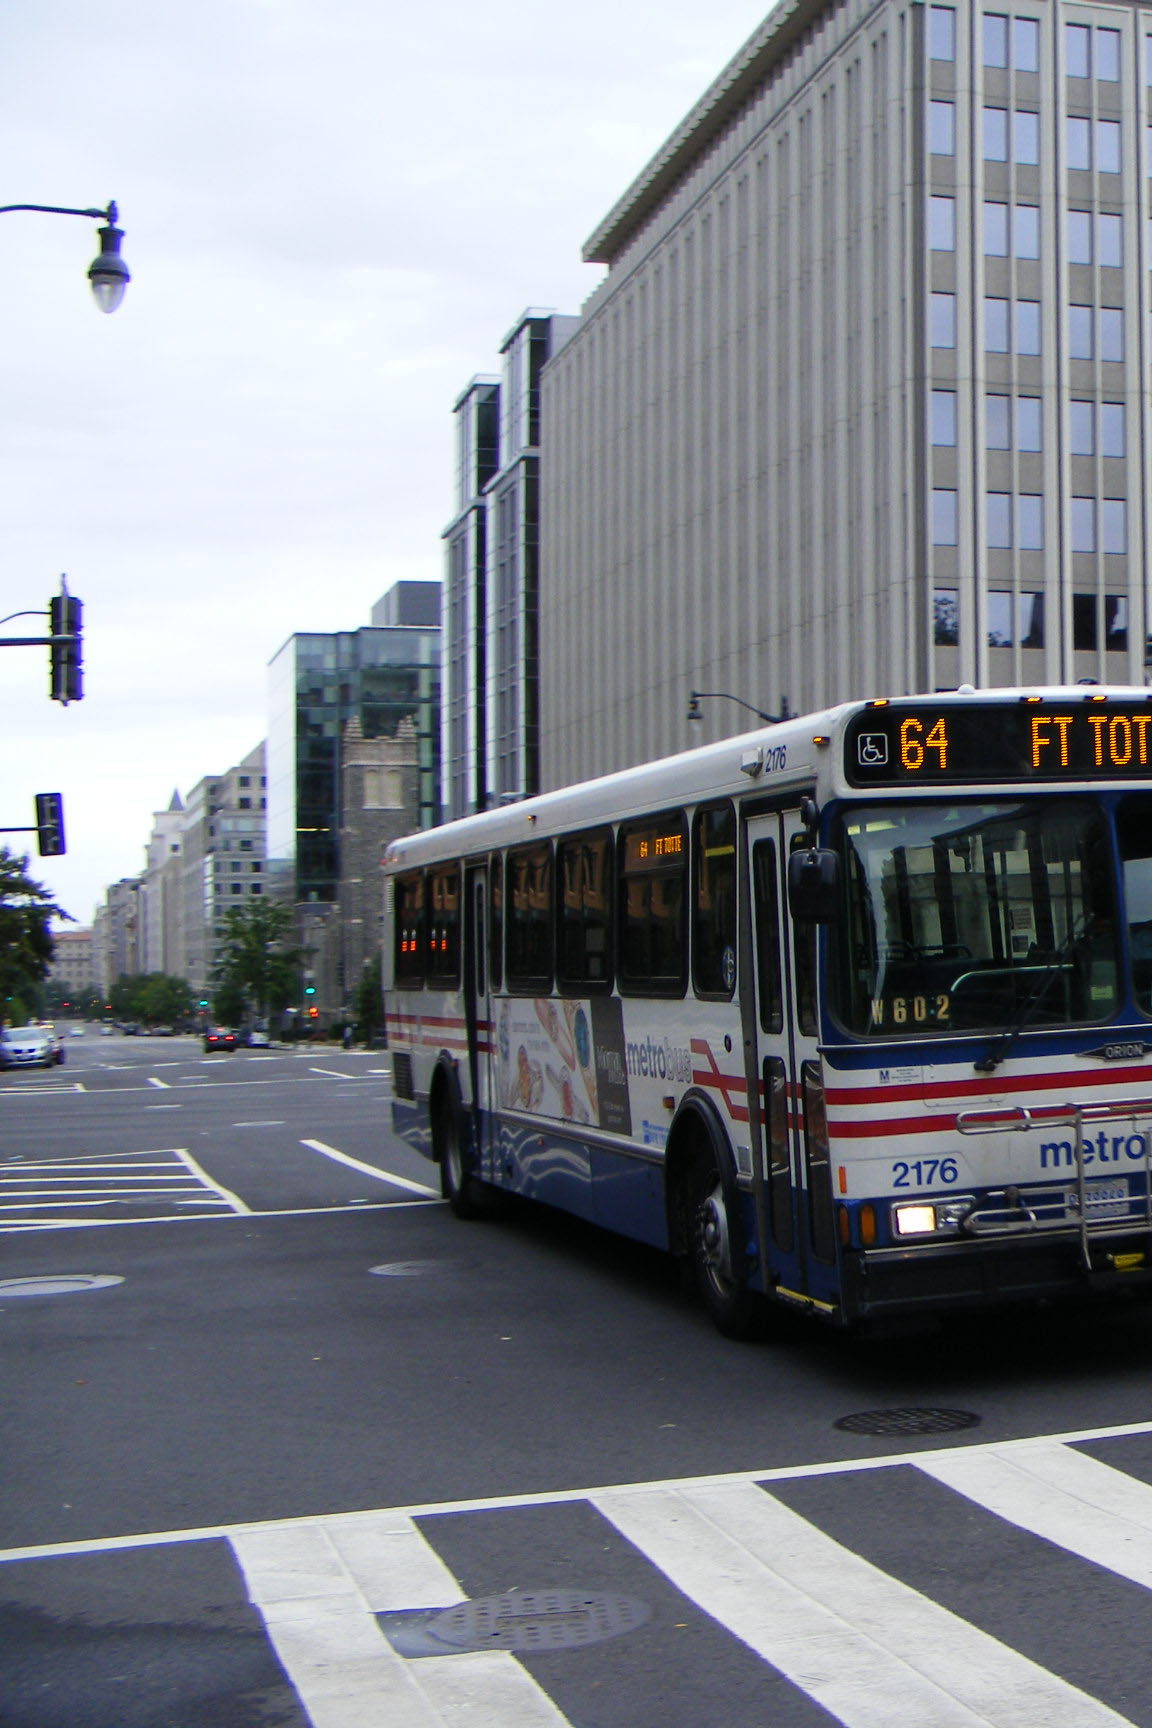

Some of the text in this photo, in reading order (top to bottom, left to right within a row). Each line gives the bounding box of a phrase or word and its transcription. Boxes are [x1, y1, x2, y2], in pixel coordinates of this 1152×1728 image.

[900, 717, 948, 769] 64
[1031, 716, 1074, 767] FT
[765, 744, 787, 773] 2176
[626, 1035, 692, 1084] metrobus
[1105, 1044, 1144, 1058] ORION
[892, 1158, 959, 1187] 2176
